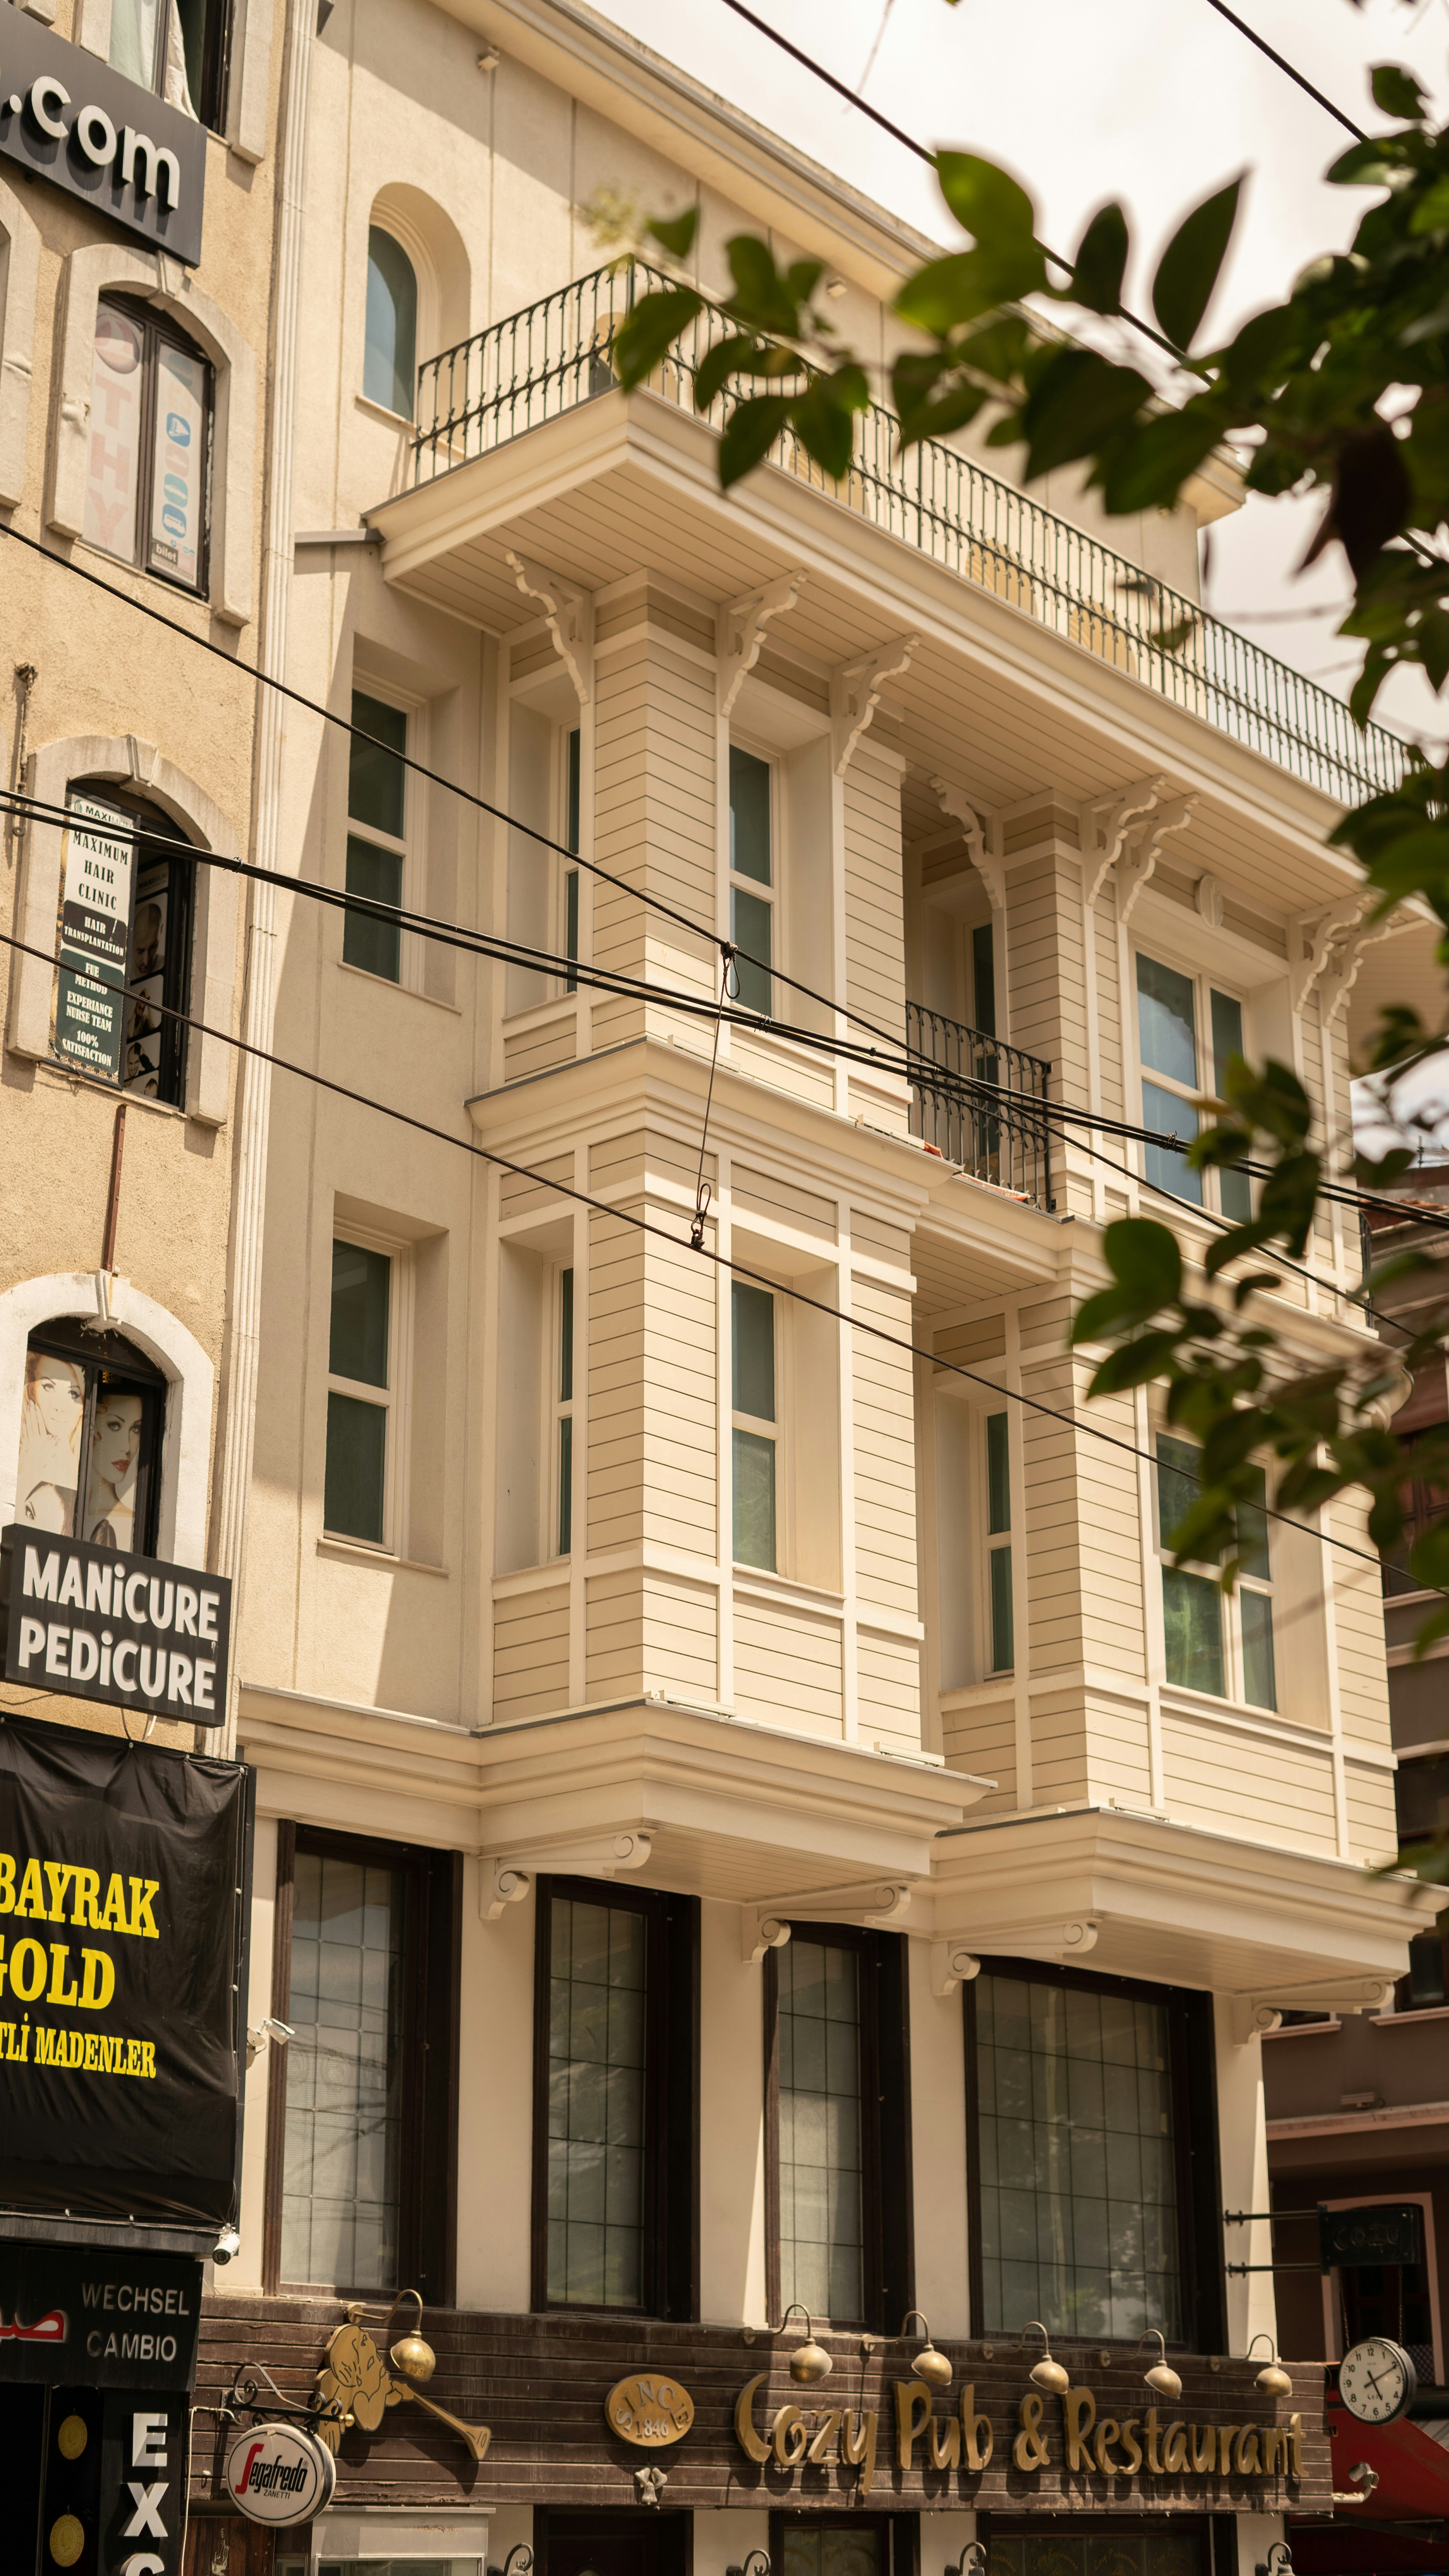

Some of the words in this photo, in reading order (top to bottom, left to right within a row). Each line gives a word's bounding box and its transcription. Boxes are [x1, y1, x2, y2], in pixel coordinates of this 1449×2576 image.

[156, 543, 177, 562] bilet
[73, 832, 128, 865] MAXIMUM
[84, 859, 114, 884] HAIR
[79, 883, 117, 910] CLINIC
[84, 916, 106, 934] HAIR
[64, 925, 124, 957] TRANSPLANTATION
[85, 962, 99, 977] FUE
[67, 990, 113, 1018] EXPERIANCE
[66, 1005, 90, 1024] NURSE
[91, 1013, 112, 1033] TEAM
[76, 1030, 99, 1048] 100%
[62, 1038, 112, 1067] SATISFACTION
[0, 1853, 159, 1938] BAYRAK
[0, 1935, 115, 2009] OLD
[34, 2026, 156, 2078] MADENLER
[82, 2282, 190, 2315] WECHSEL
[86, 2330, 177, 2362] CAMBIO
[1367, 2348, 1374, 2356] 12
[1348, 2364, 1355, 2372] 10
[1346, 2379, 1352, 2388] 9
[1396, 2376, 1401, 2384] 3
[615, 2380, 691, 2431] SINCE
[1351, 2394, 1357, 2403] 8
[1394, 2391, 1399, 2399] 4
[1362, 2404, 1367, 2413] 7
[1373, 2408, 1379, 2416] 6
[1385, 2403, 1391, 2411] 5
[635, 2418, 669, 2439] 1846
[734, 2373, 877, 2495] Cozy
[893, 2381, 994, 2470] Pub
[1012, 2394, 1051, 2471] &
[1060, 2386, 1309, 2476] Restaurant
[263, 2489, 291, 2500] ZANETTI
